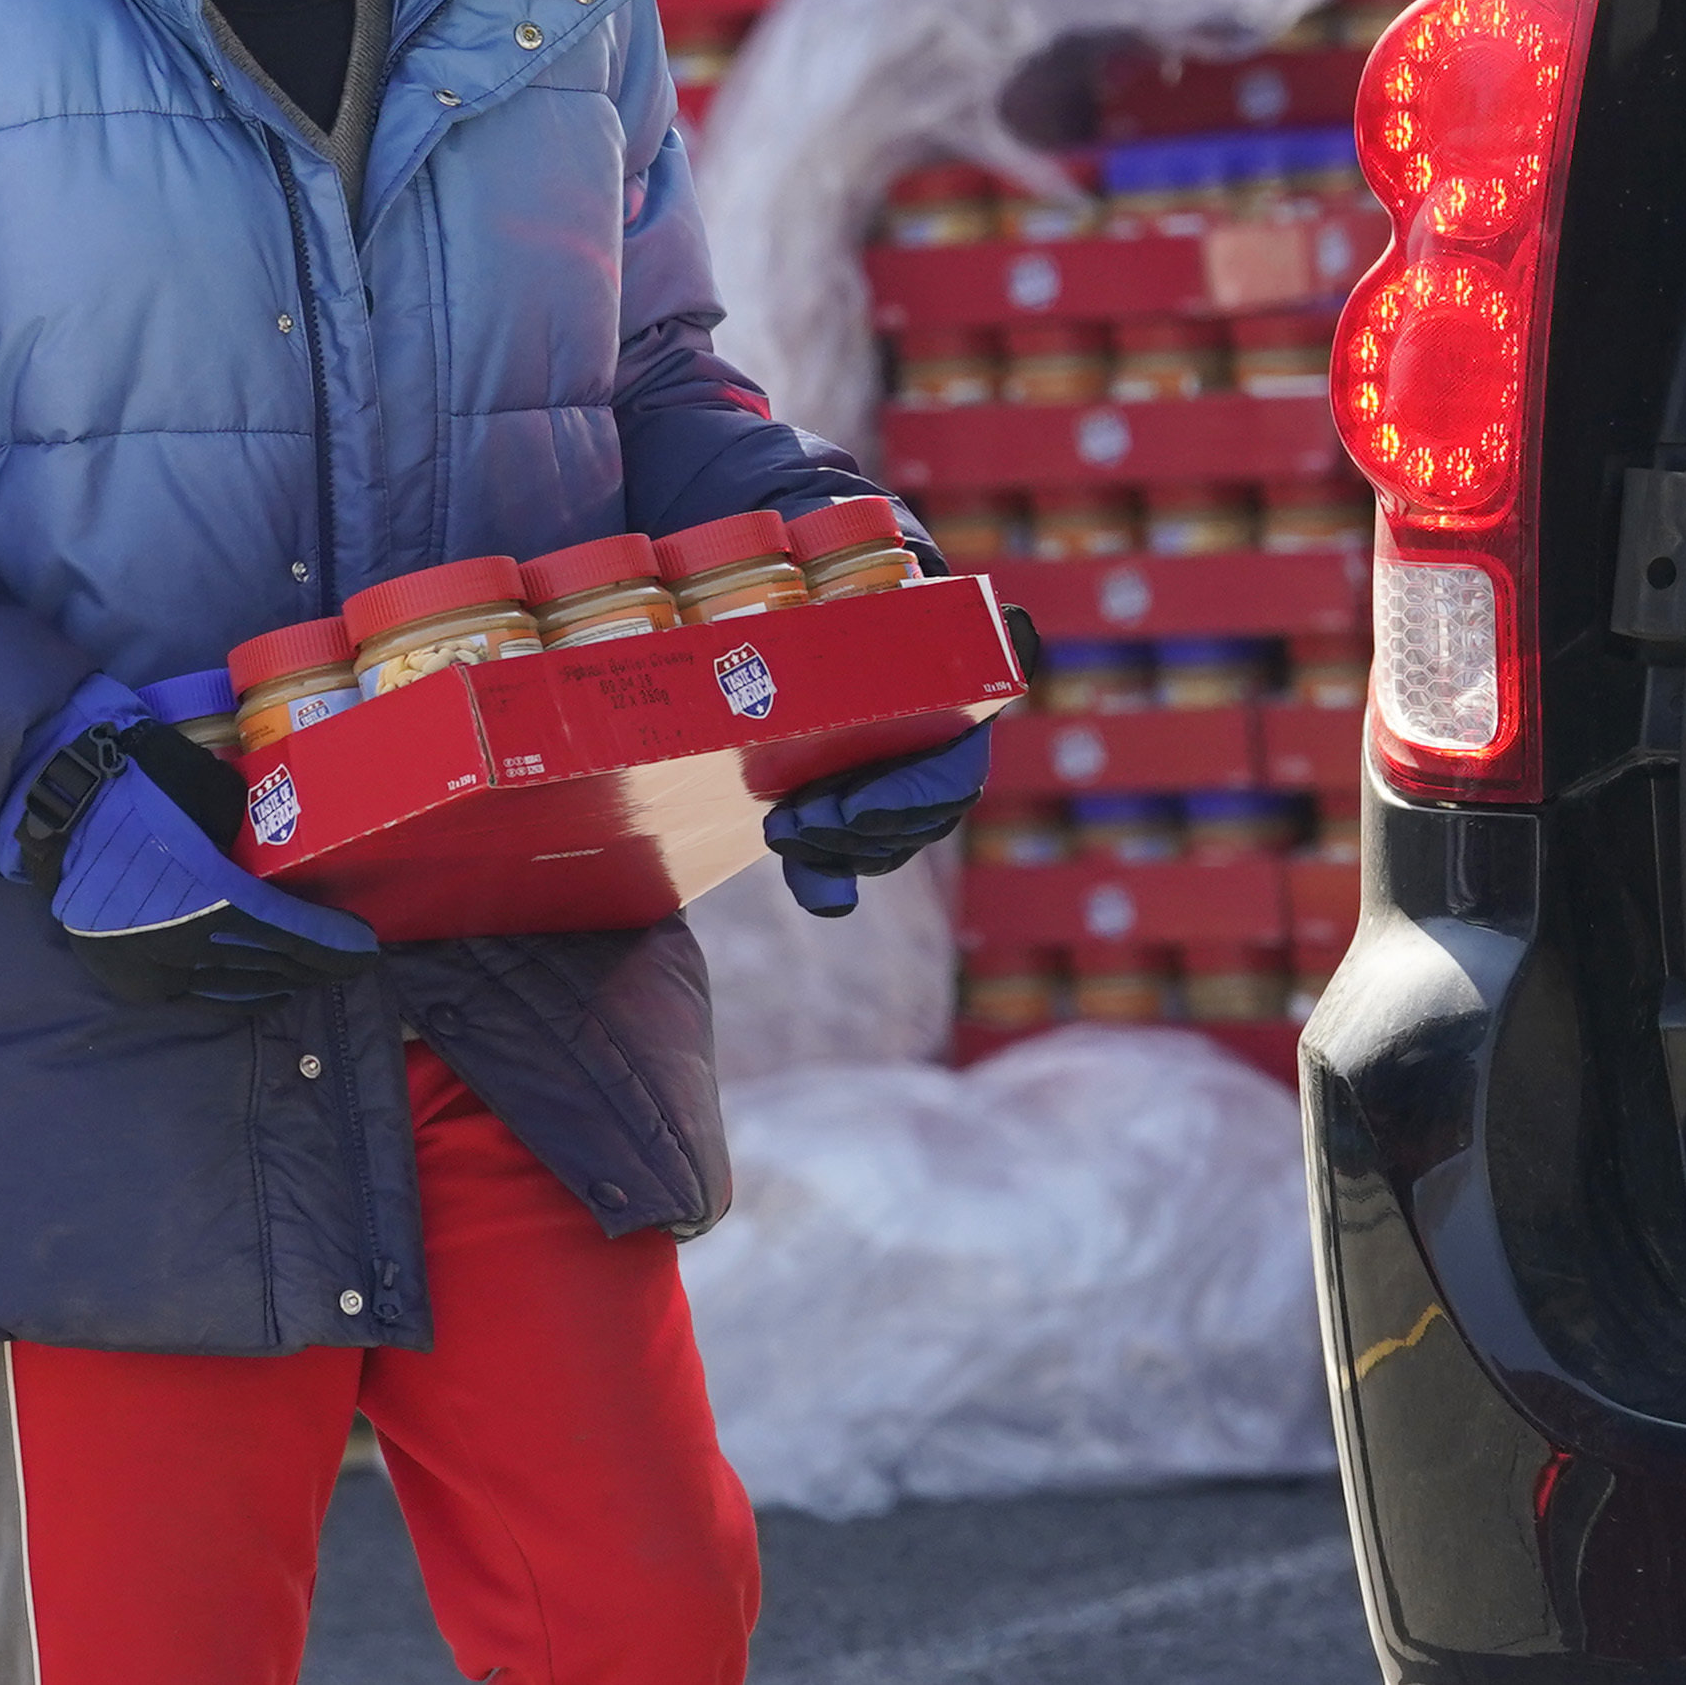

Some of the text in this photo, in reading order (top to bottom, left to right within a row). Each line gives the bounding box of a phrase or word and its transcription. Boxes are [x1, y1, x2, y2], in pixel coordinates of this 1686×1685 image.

[724, 661, 763, 693] TASTE OF
[727, 675, 777, 716] AMERICA
[254, 781, 292, 822] TASTE OF
[255, 796, 302, 846] AMERICA
